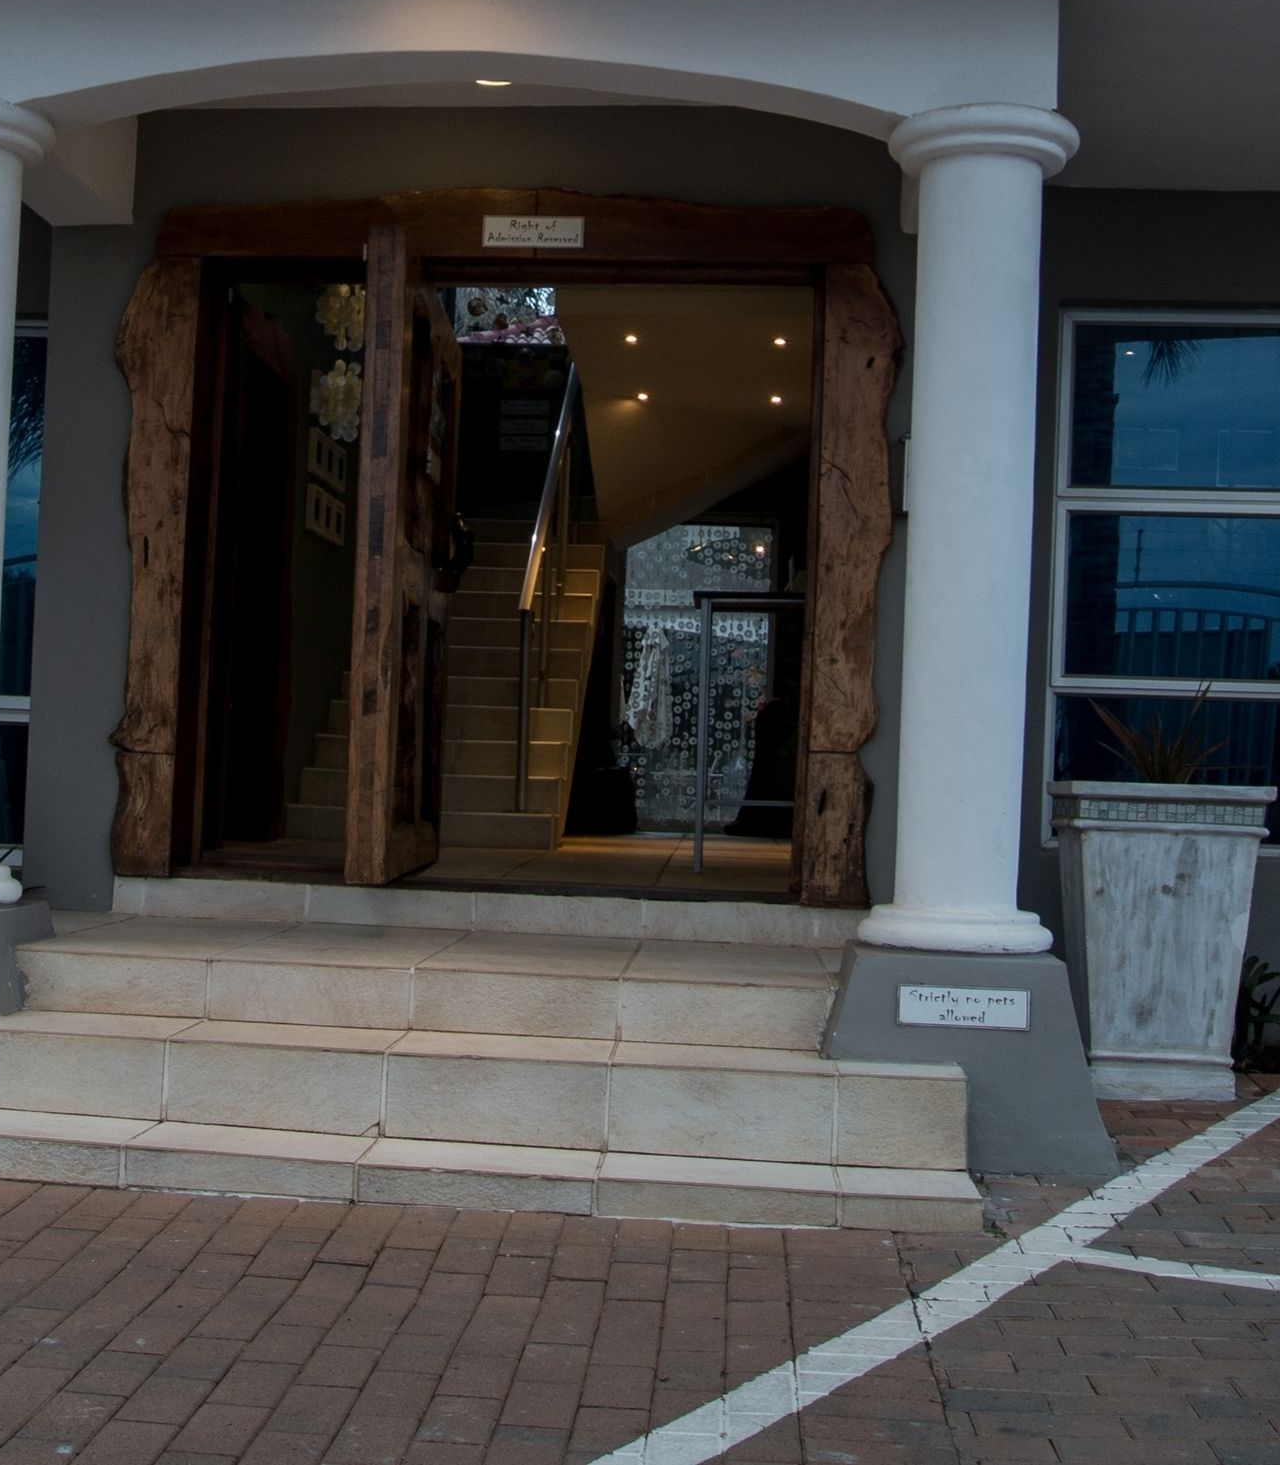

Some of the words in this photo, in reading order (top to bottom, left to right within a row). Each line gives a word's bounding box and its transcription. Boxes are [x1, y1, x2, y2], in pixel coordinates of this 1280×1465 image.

[510, 219, 539, 232] Right
[545, 219, 558, 232] of
[909, 989, 958, 1007] Strictly
[966, 996, 981, 1004] no
[987, 996, 1016, 1007] pets
[939, 1009, 986, 1023] allowed
